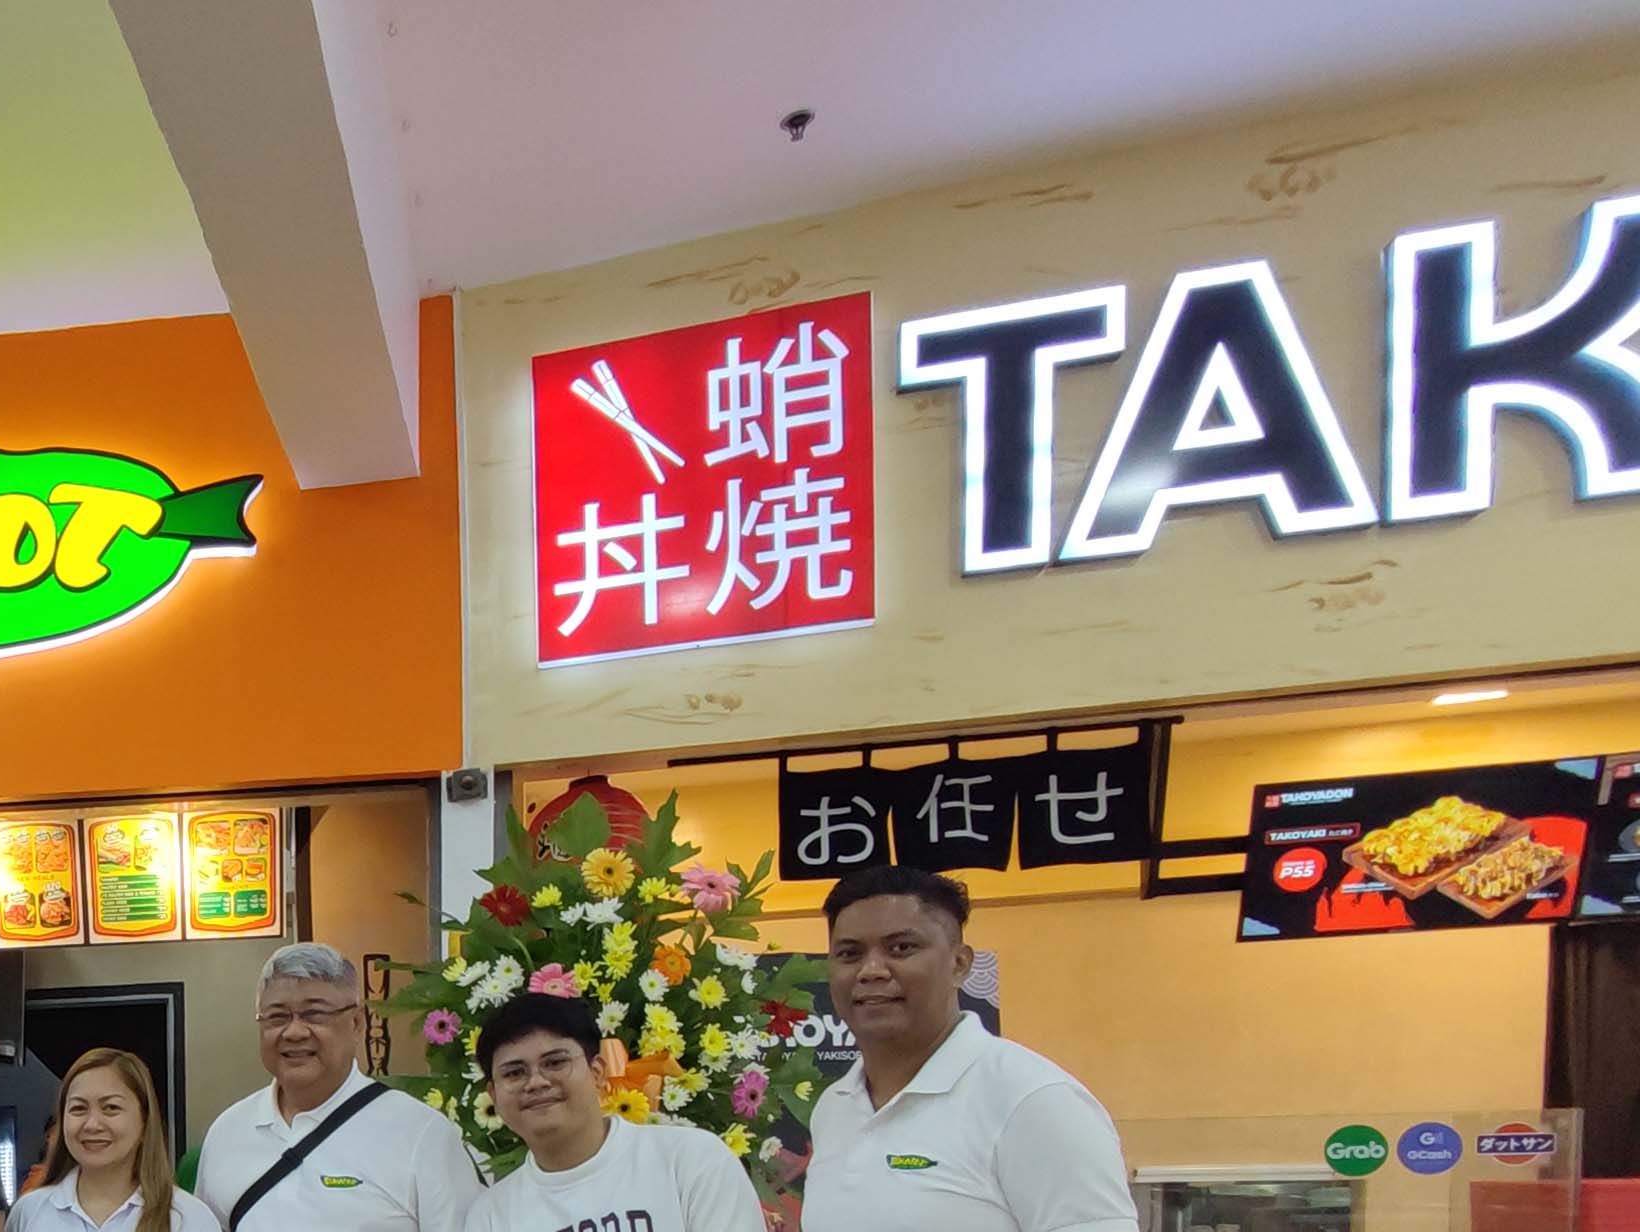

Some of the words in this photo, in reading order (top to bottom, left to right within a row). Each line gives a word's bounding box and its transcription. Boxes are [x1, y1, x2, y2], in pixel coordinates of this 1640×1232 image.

[896, 192, 1640, 578] TAK
[1281, 788, 1354, 804] TAKOYADON
[797, 772, 1124, 865] お任せ
[1270, 829, 1327, 841] TAKOYAKI
[1327, 1141, 1385, 1160] Grab
[1479, 1138, 1552, 1151] ダットサン
[1407, 1149, 1452, 1160] GCash
